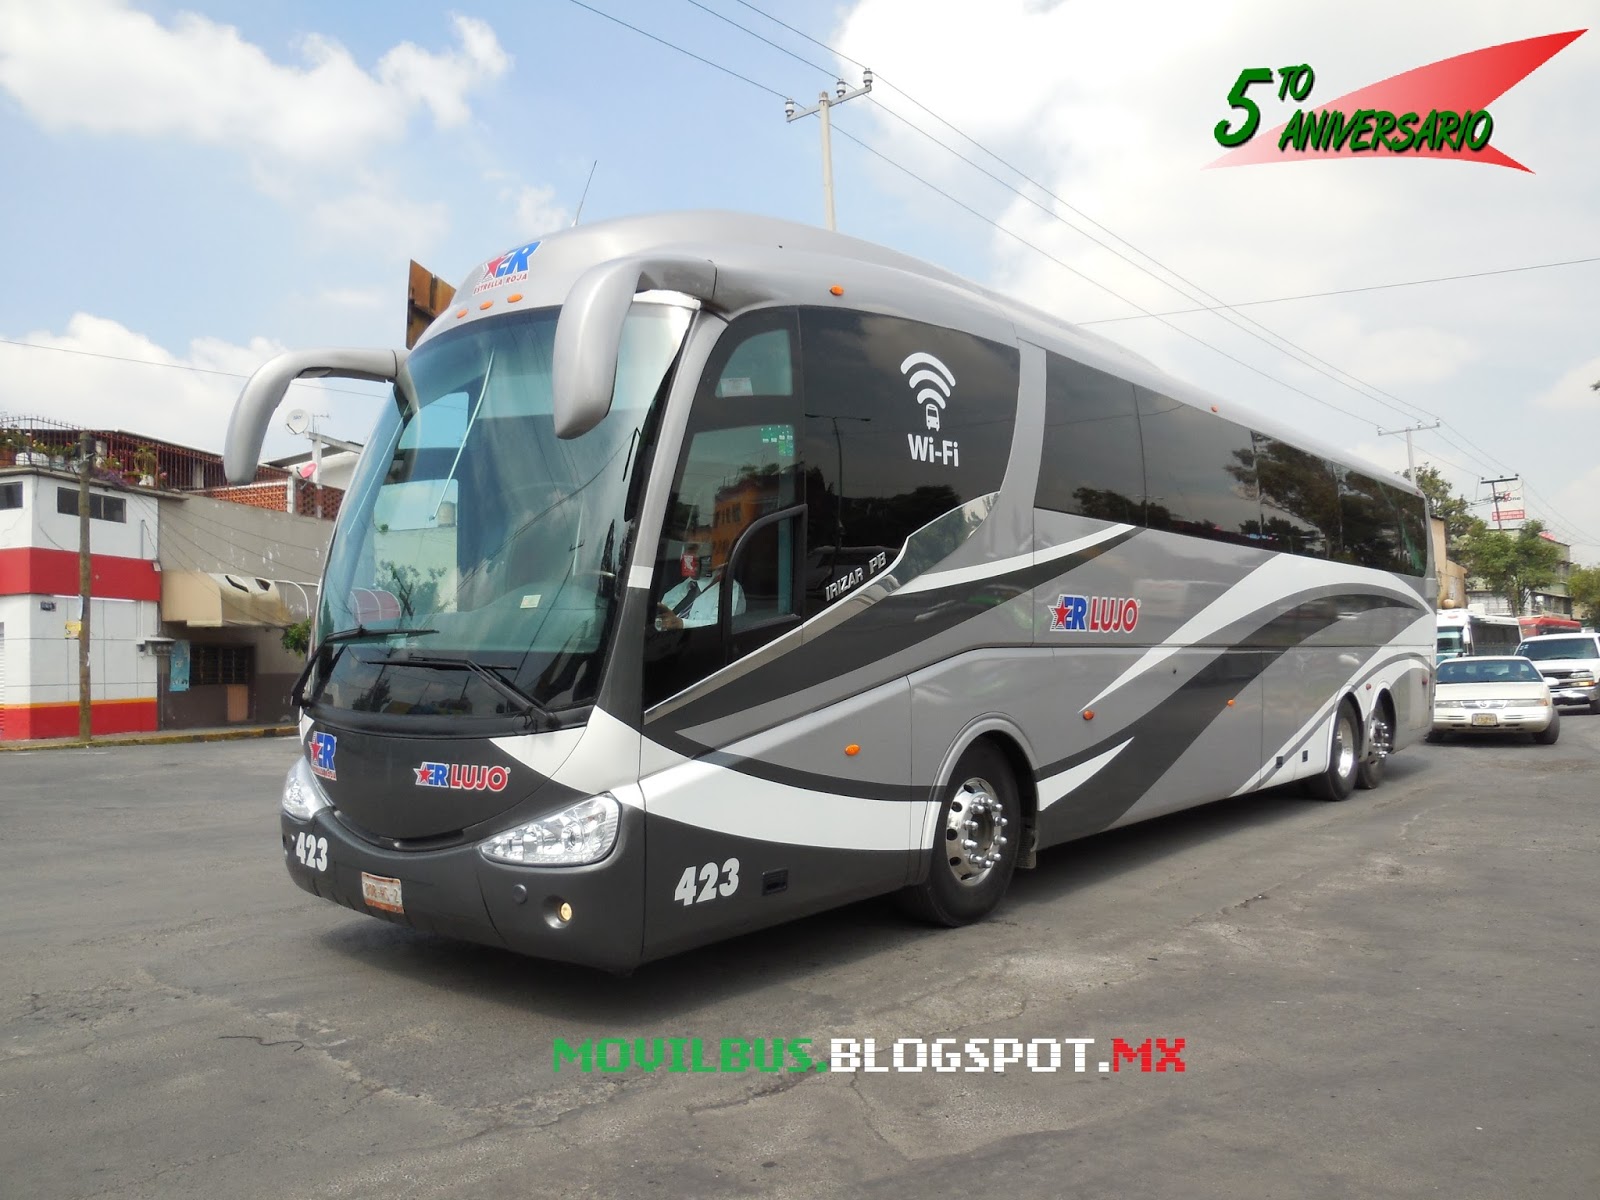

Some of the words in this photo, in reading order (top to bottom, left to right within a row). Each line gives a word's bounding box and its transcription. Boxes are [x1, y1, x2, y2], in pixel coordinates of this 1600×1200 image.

[473, 279, 503, 295] ESTRELLA
[505, 273, 528, 284] ROJA
[907, 433, 959, 467] Wi-Fi
[825, 567, 864, 602] IRIZAR
[868, 551, 887, 575] PB
[1089, 596, 1139, 633] LUJO
[450, 764, 508, 791] LUJO
[296, 831, 328, 872] 423
[674, 857, 740, 906] 423
